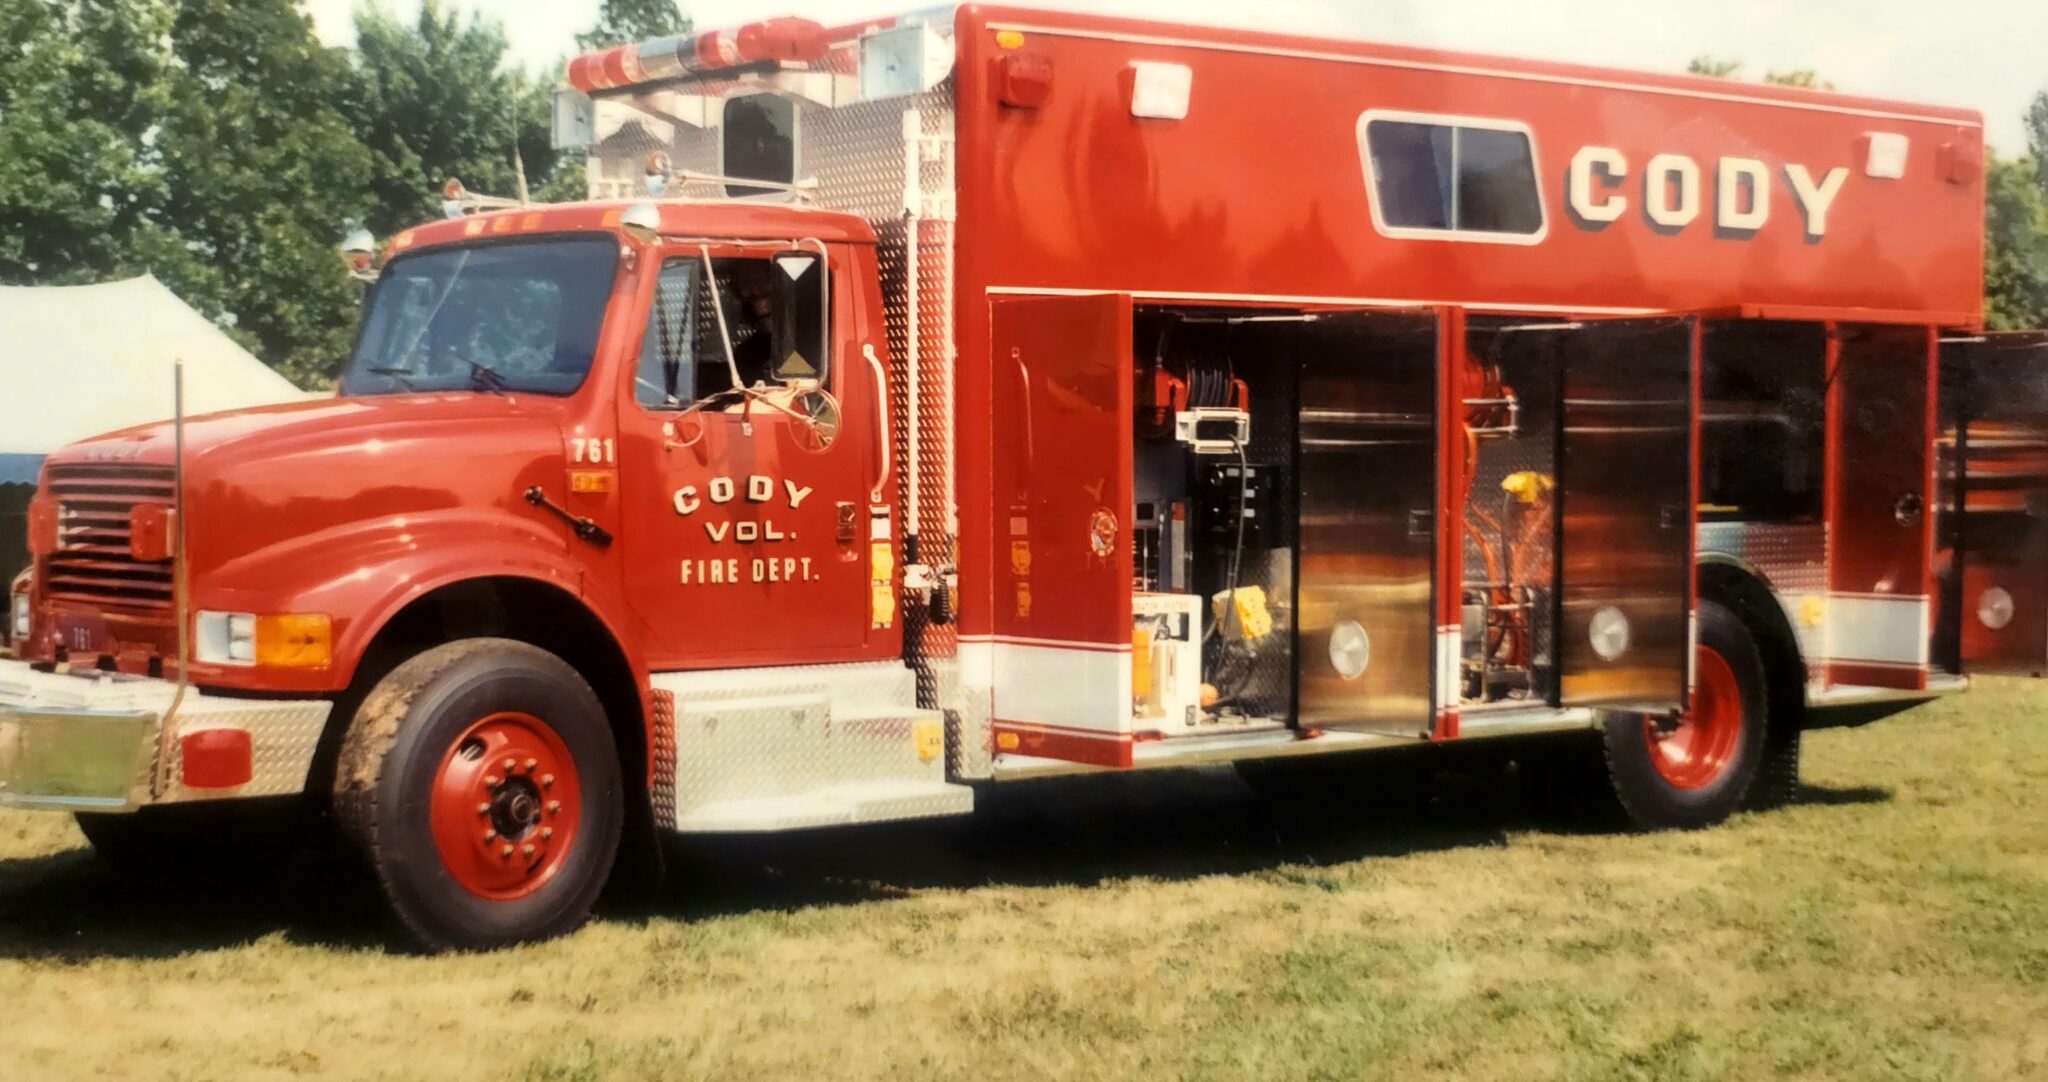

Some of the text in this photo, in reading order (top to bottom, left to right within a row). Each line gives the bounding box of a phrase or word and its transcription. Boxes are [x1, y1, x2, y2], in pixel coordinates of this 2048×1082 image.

[1566, 145, 1849, 243] CODY
[571, 438, 614, 463] 761
[673, 475, 813, 515] CODY
[705, 520, 798, 542] VOL.
[680, 557, 820, 584] FIRE DEPT.
